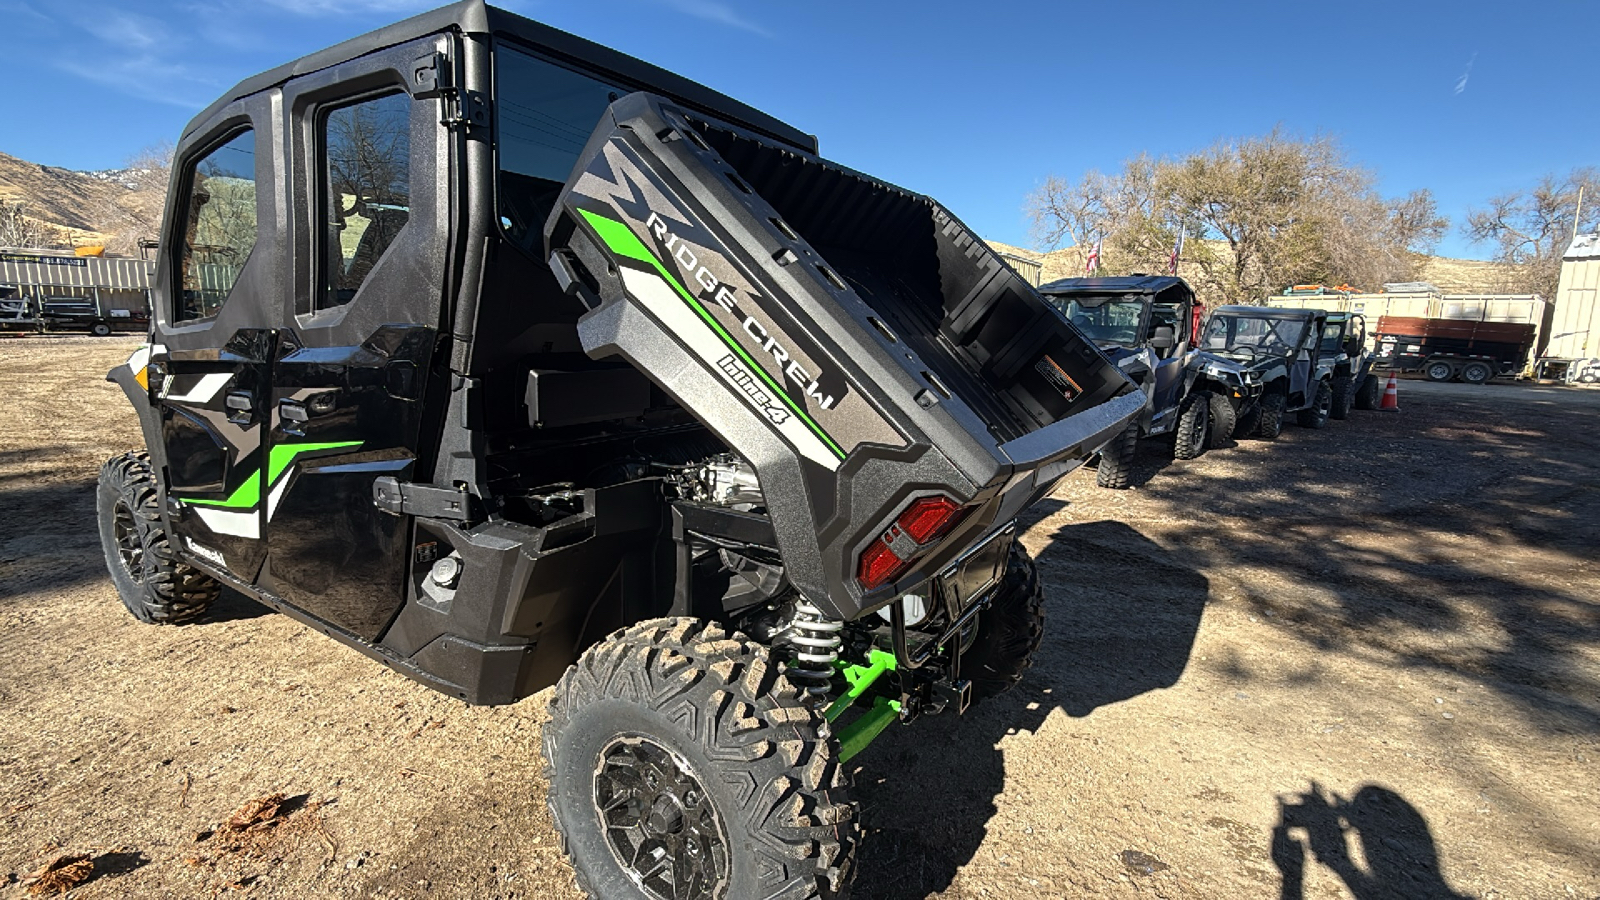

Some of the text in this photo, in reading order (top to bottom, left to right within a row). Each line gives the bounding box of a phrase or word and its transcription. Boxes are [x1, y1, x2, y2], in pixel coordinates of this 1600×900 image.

[645, 211, 834, 410] RIDGE CREW
[716, 353, 790, 425] Inline-4
